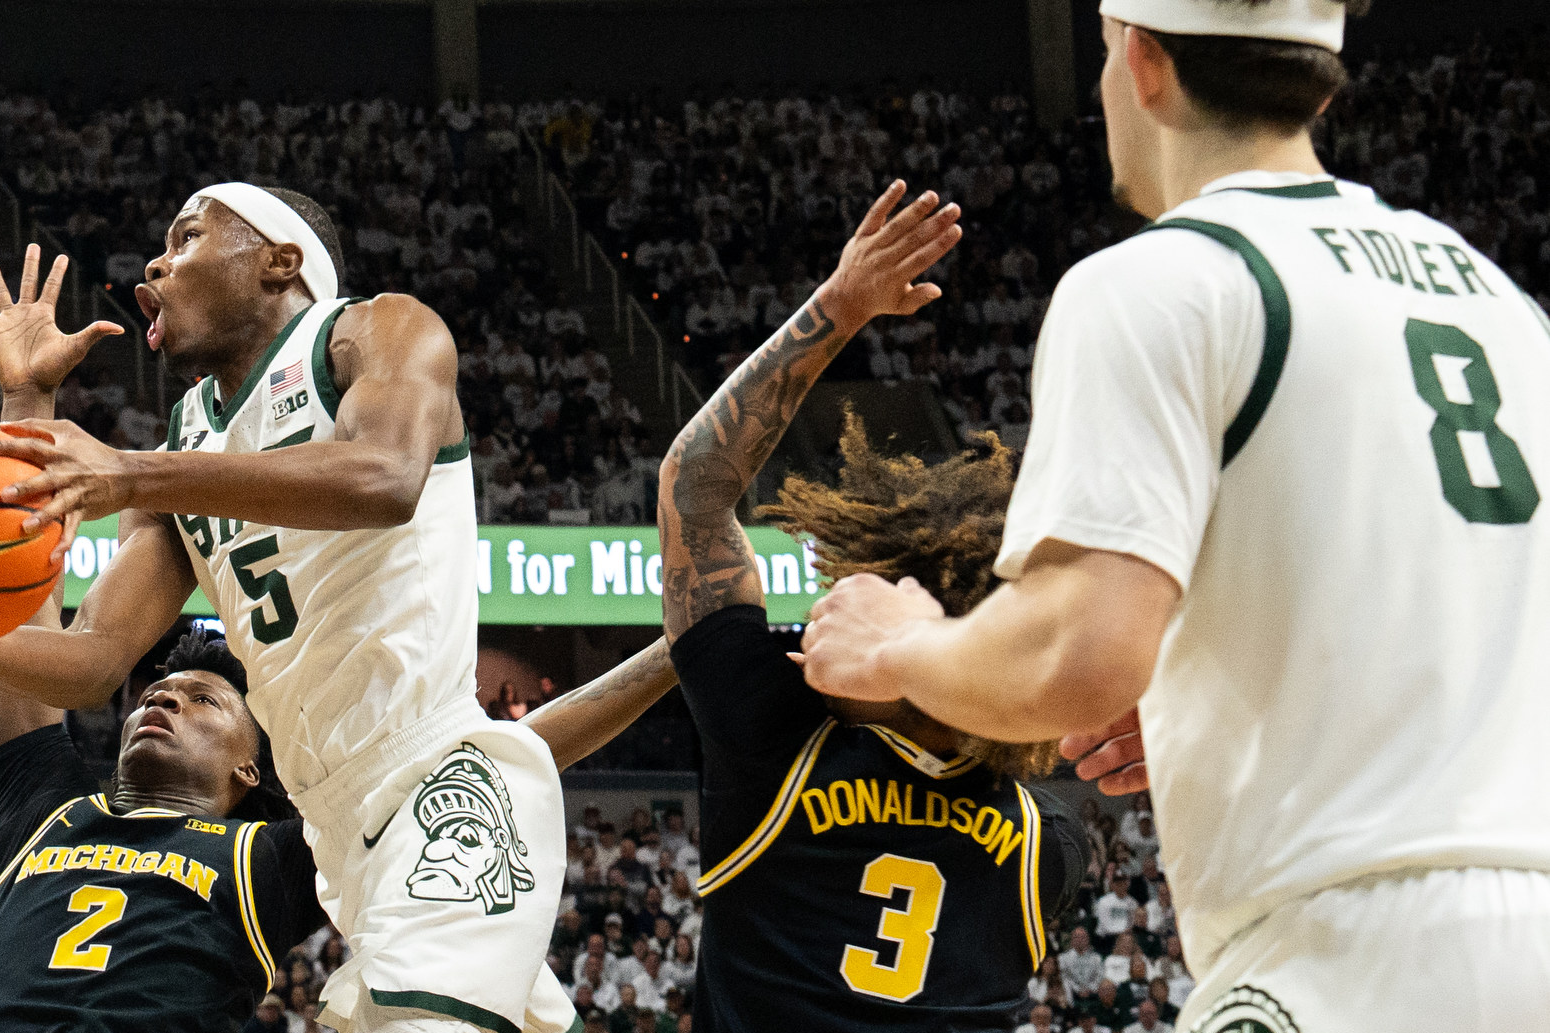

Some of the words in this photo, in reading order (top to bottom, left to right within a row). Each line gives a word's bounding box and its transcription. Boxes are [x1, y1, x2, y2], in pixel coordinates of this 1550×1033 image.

[1311, 227, 1497, 297] FIDLER
[1404, 317, 1540, 525] 8
[229, 533, 300, 645] 5
[507, 540, 575, 595] for
[801, 778, 1023, 866] DONALDSON
[15, 844, 219, 902] MICHIGAN
[48, 884, 129, 971] 2
[839, 853, 947, 1003] 3
